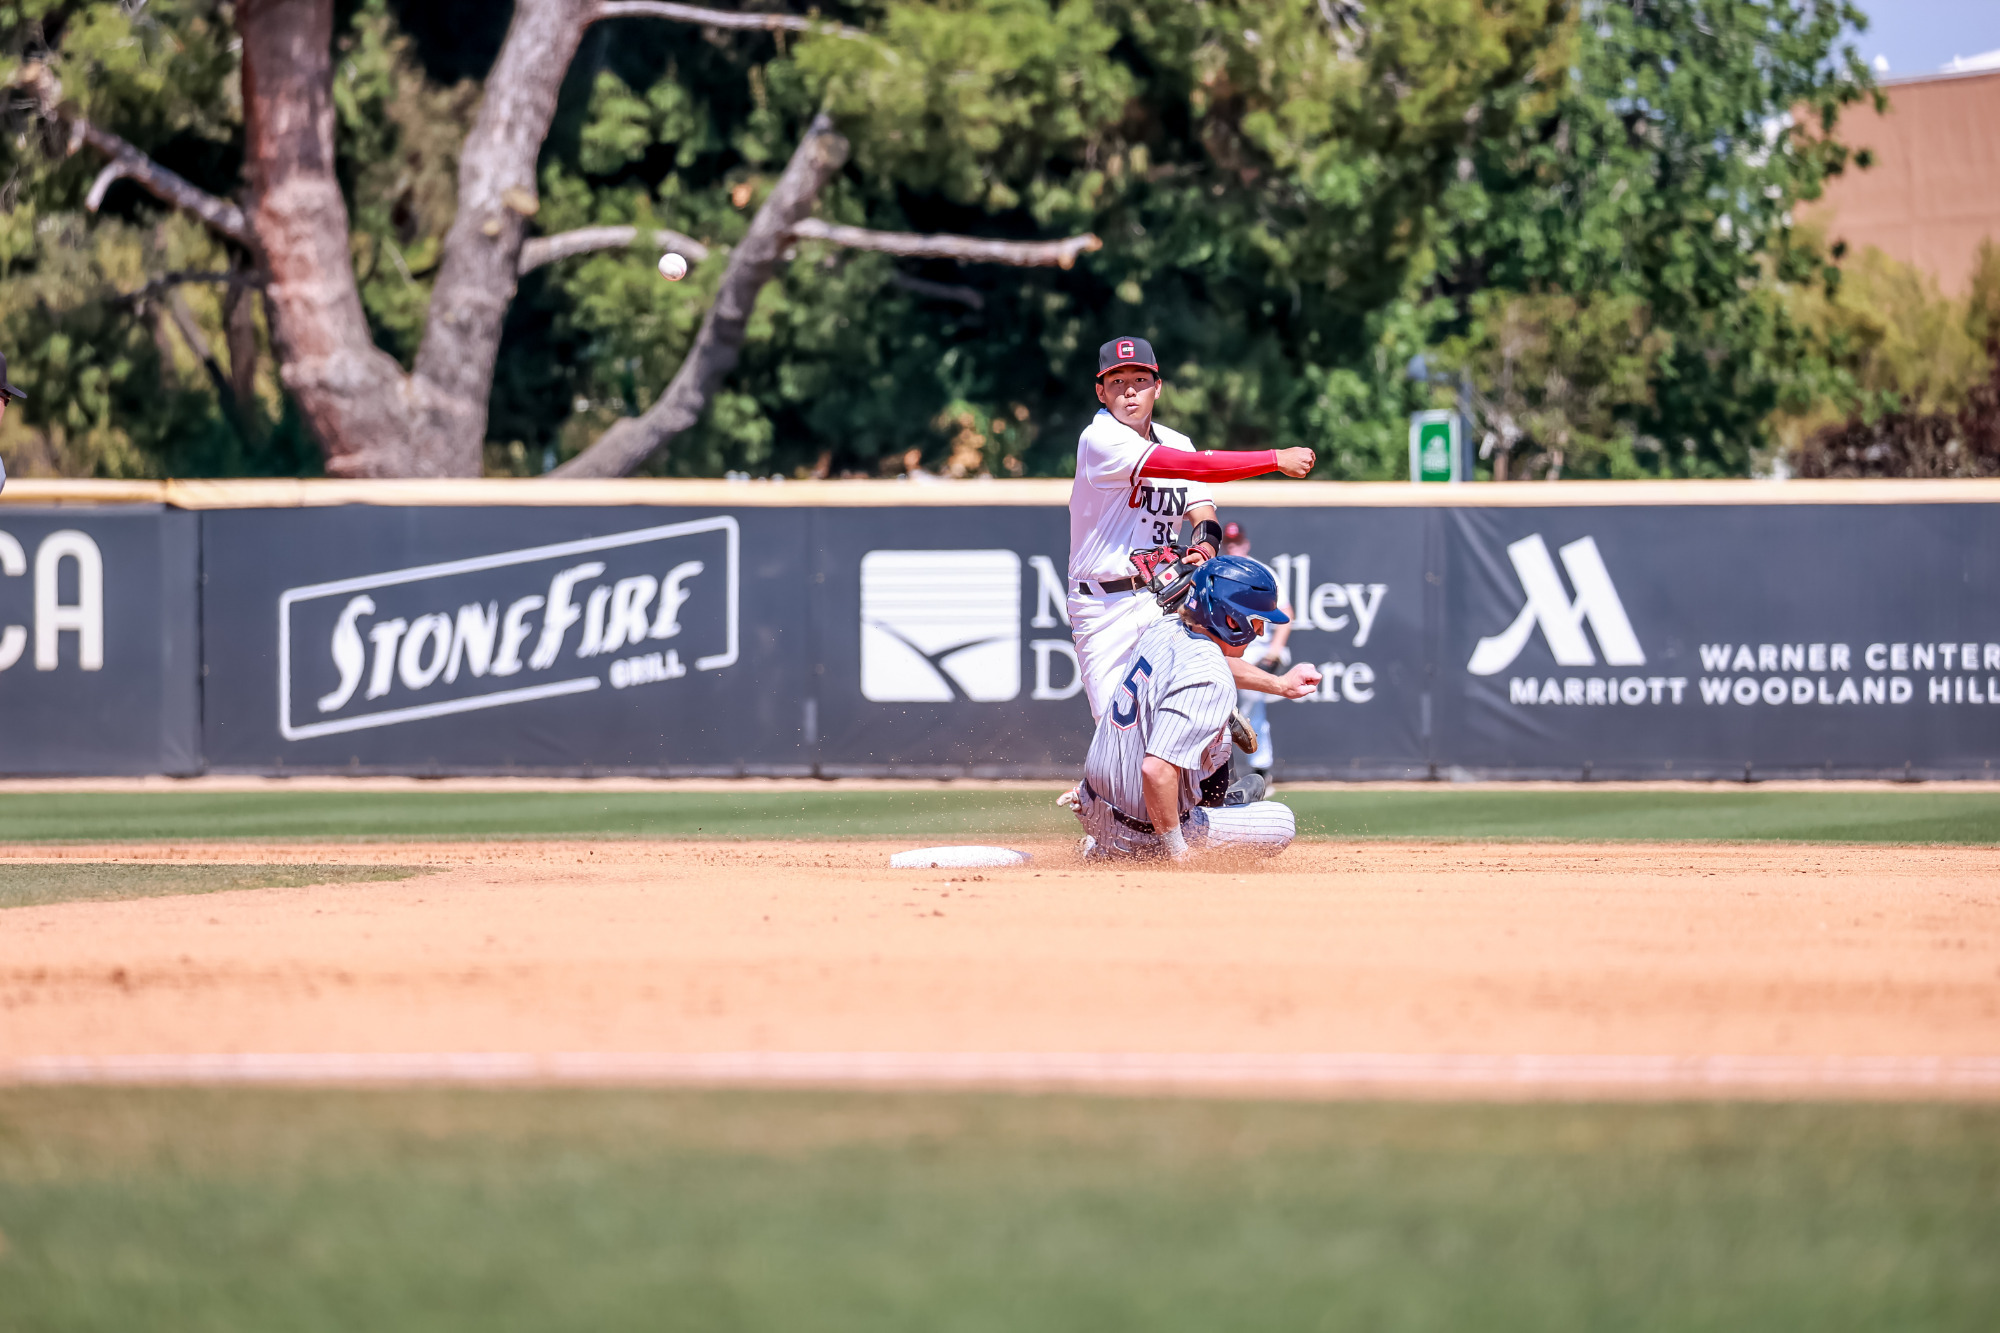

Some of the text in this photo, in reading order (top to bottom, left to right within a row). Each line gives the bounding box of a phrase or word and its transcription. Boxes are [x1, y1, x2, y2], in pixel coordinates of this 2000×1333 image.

[1129, 479, 1188, 516] CUN
[1270, 553, 1389, 647] lley
[1699, 642, 2000, 672] WARNER CENTER
[1110, 655, 1153, 731] 5
[1509, 676, 2000, 705] MARRIOTT WOODLAND HILL
